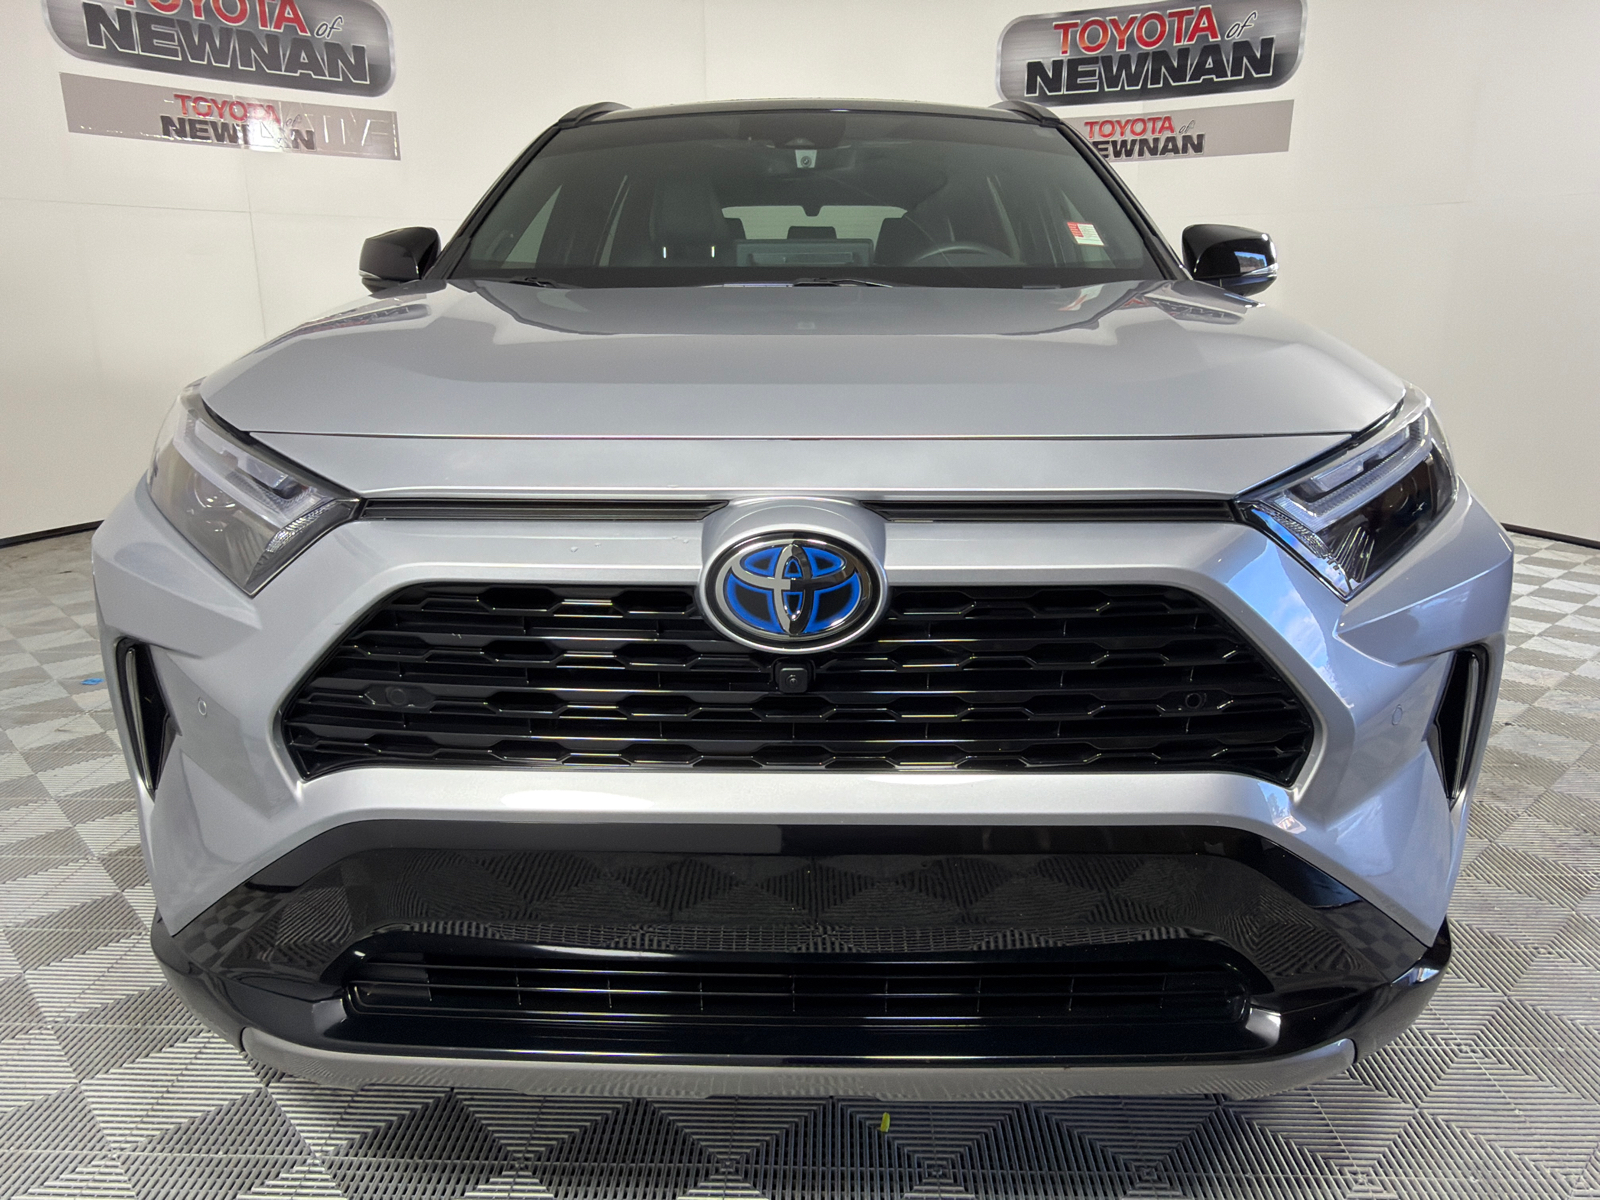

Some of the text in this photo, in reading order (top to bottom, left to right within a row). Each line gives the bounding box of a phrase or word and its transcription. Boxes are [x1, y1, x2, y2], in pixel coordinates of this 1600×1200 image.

[123, 0, 344, 38] YOTA of
[1053, 5, 1257, 56] TOYOTA of
[82, 1, 370, 84] NEWNAN
[1025, 36, 1275, 96] NEWNAN
[173, 94, 281, 125] TOYOTA
[1084, 116, 1195, 139] TOYOTA of
[1091, 133, 1205, 159] EWNAN
